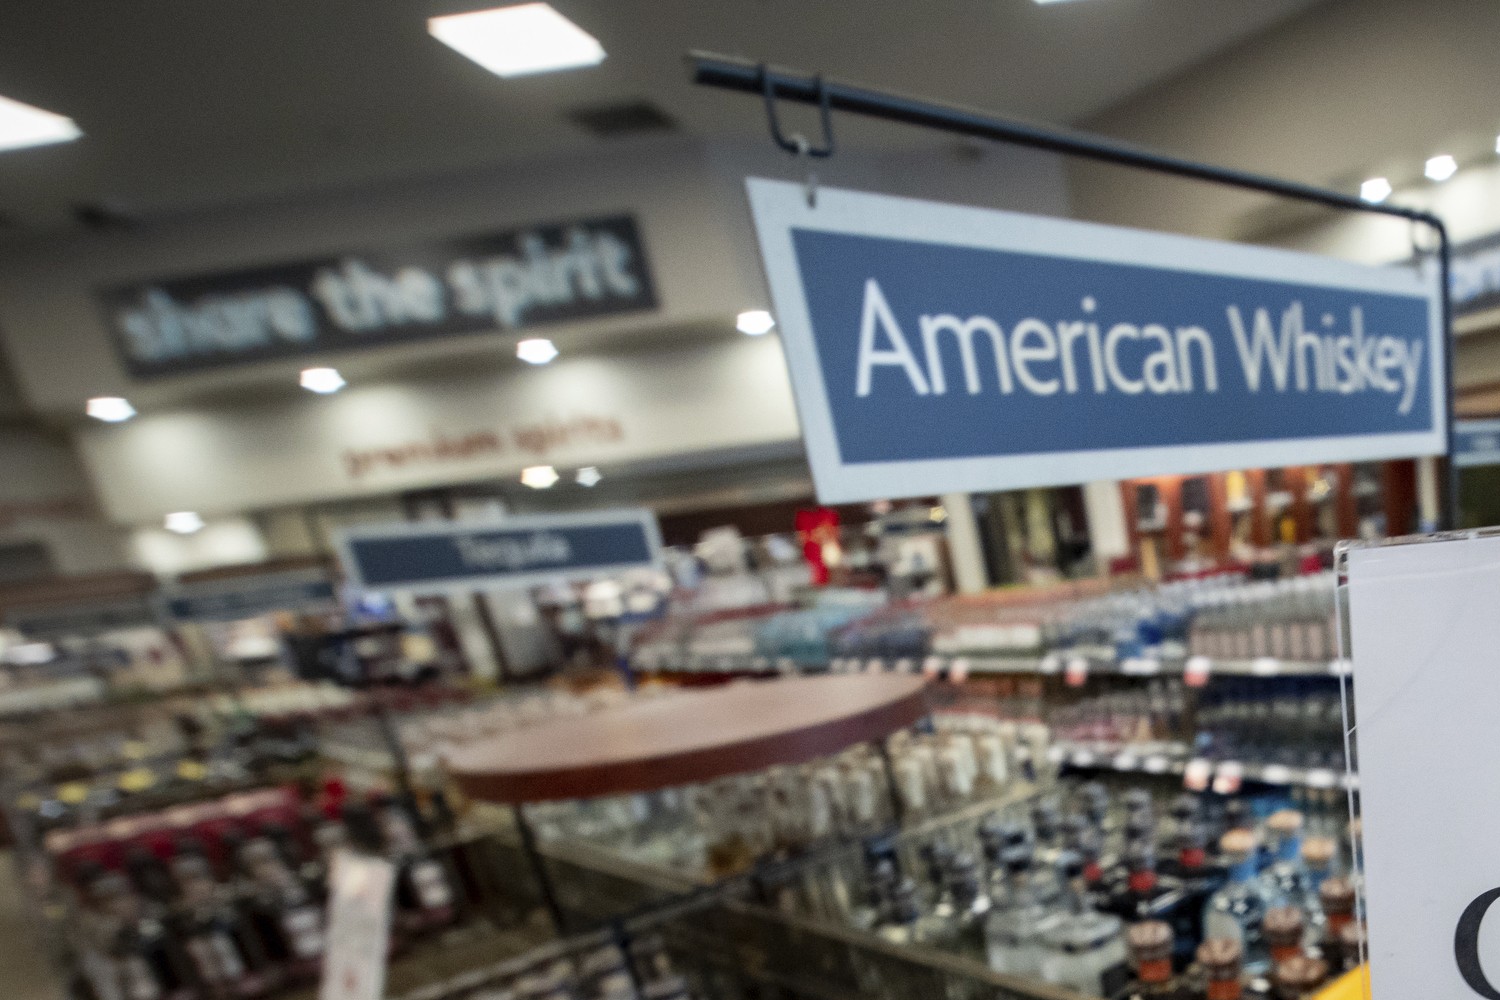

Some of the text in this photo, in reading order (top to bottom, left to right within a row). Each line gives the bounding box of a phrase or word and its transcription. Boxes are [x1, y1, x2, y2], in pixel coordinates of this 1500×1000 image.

[120, 228, 638, 362] share the spirit
[855, 278, 1422, 415] American Whiskey
